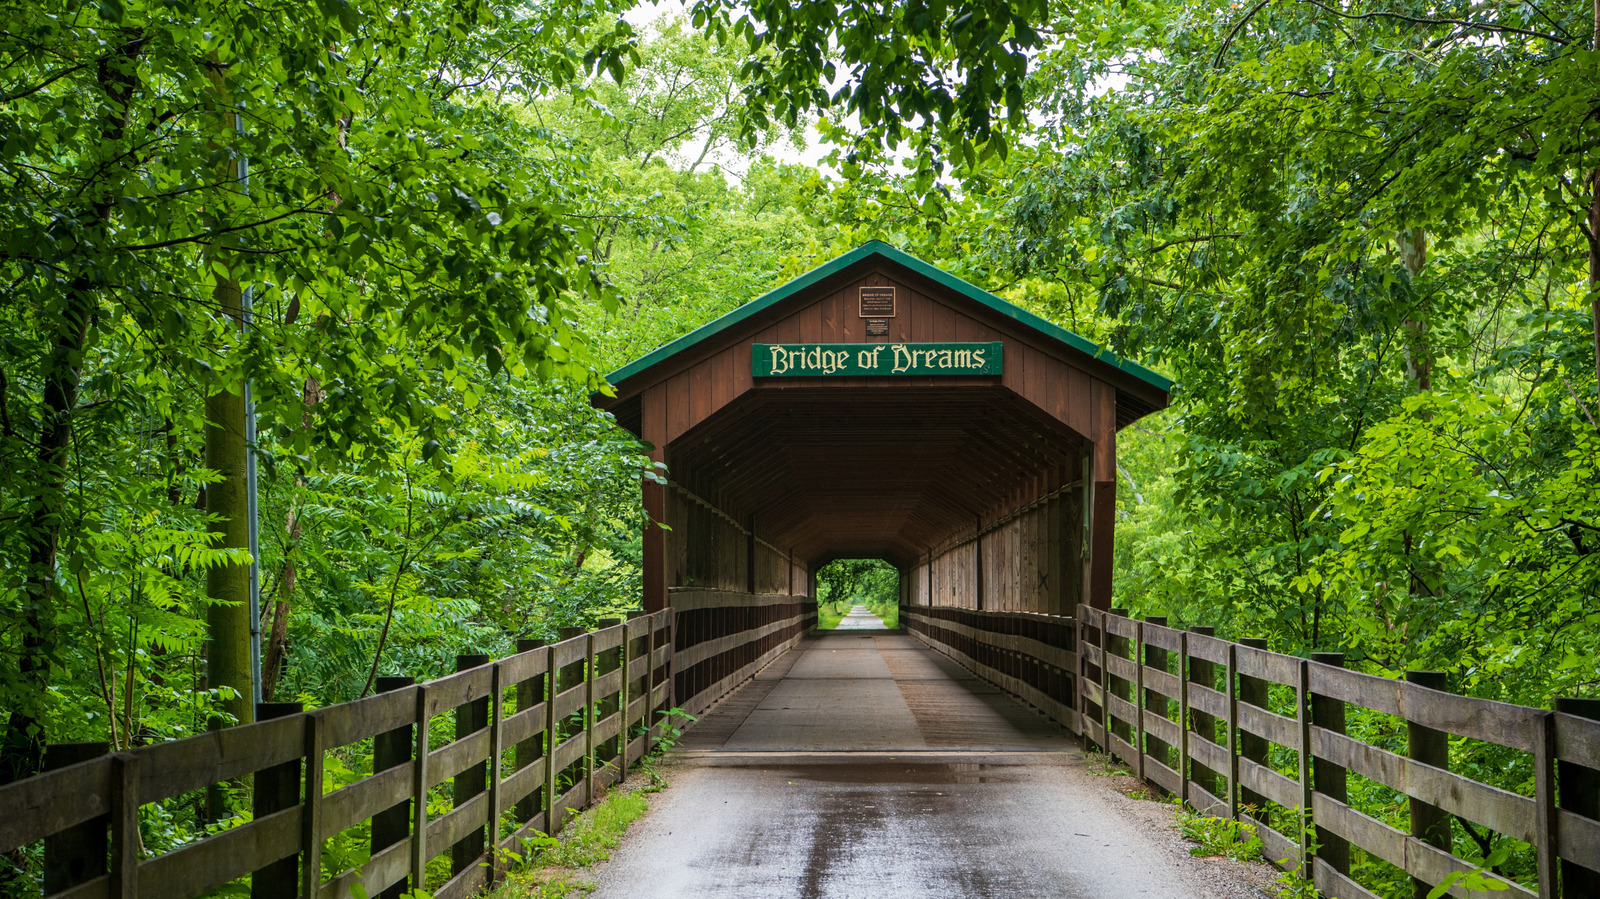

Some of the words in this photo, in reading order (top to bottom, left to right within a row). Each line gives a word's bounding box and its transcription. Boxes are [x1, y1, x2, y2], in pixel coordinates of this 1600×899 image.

[769, 344, 850, 375] Bridge
[857, 345, 886, 369] of
[891, 343, 986, 374] Dreams
